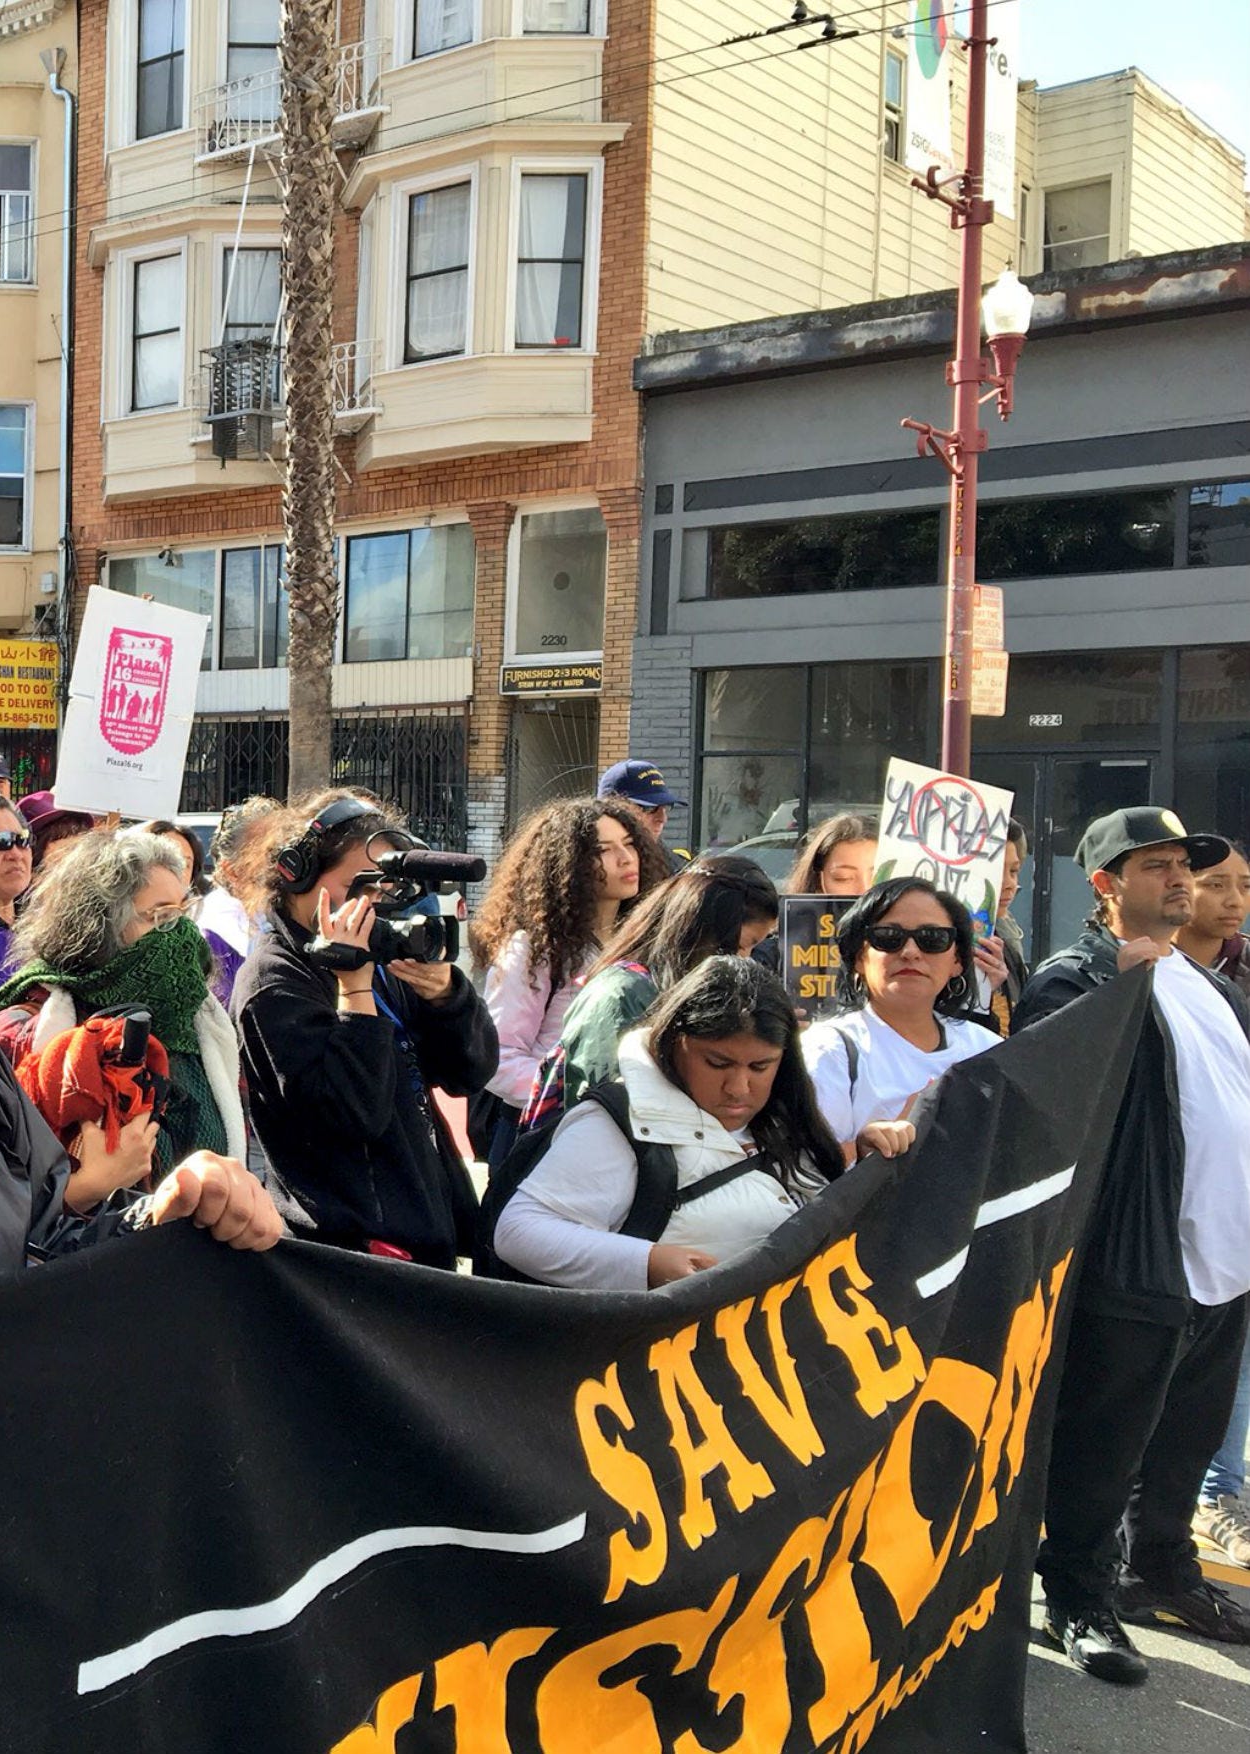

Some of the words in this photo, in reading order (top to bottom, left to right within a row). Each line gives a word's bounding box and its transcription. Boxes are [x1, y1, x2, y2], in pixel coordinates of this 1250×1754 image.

[541, 634, 567, 646] 2230
[116, 652, 161, 672] Plaza
[114, 665, 132, 681] 16
[504, 669, 554, 686] FURNISHED
[571, 667, 602, 680] ROOMS
[17, 684, 31, 695] TO
[33, 684, 47, 695] GO
[8, 698, 55, 709] DELIVERY
[1029, 714, 1063, 727] 2224
[574, 1232, 927, 1604] SAVE
[330, 1247, 1075, 1754] ISSION
